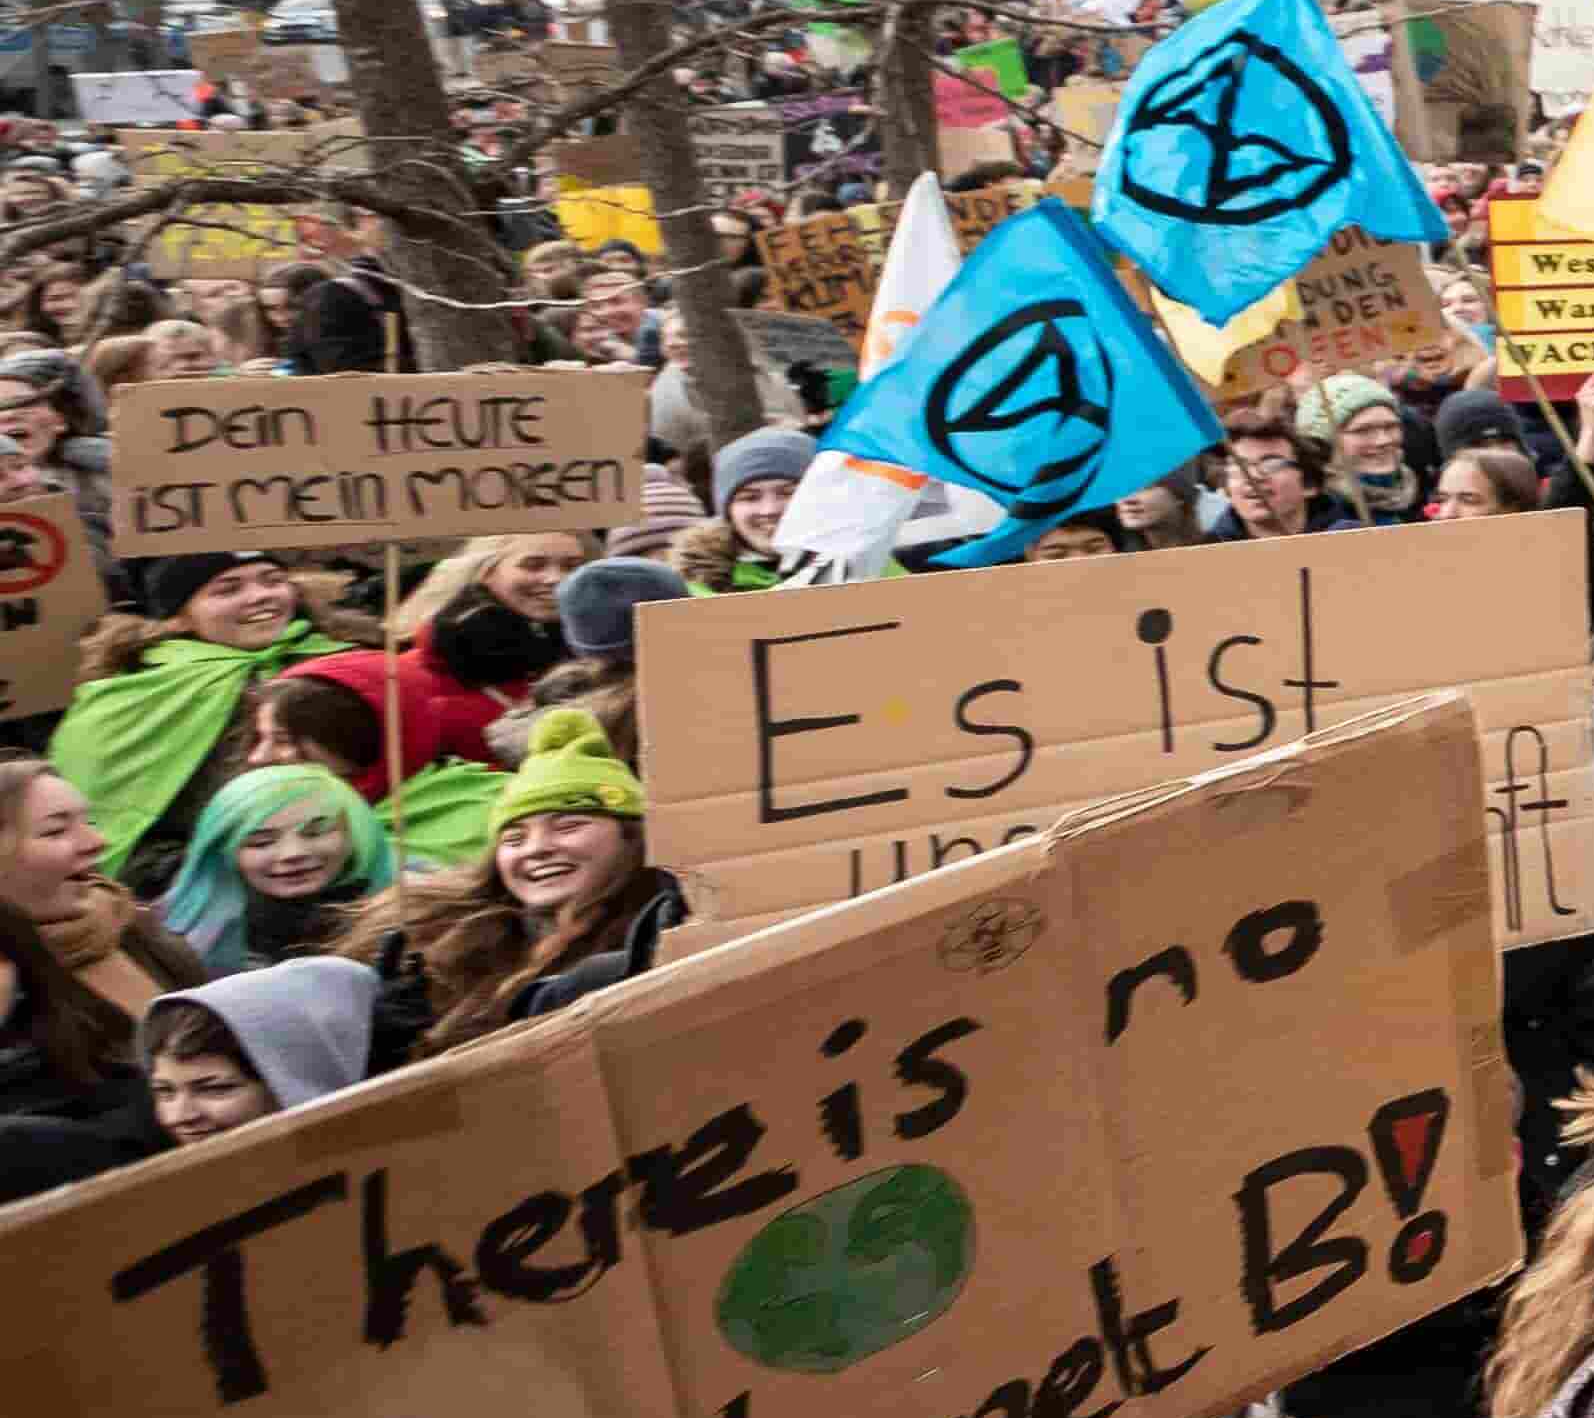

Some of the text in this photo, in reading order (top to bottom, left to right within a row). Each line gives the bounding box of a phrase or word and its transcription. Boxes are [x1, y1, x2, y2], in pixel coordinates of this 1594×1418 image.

[368, 394, 548, 452] HEUTE
[751, 566, 1340, 825] Es ist
[848, 823, 1044, 901] un
[110, 893, 1326, 1408] There is no
[1234, 1086, 1452, 1338] B!
